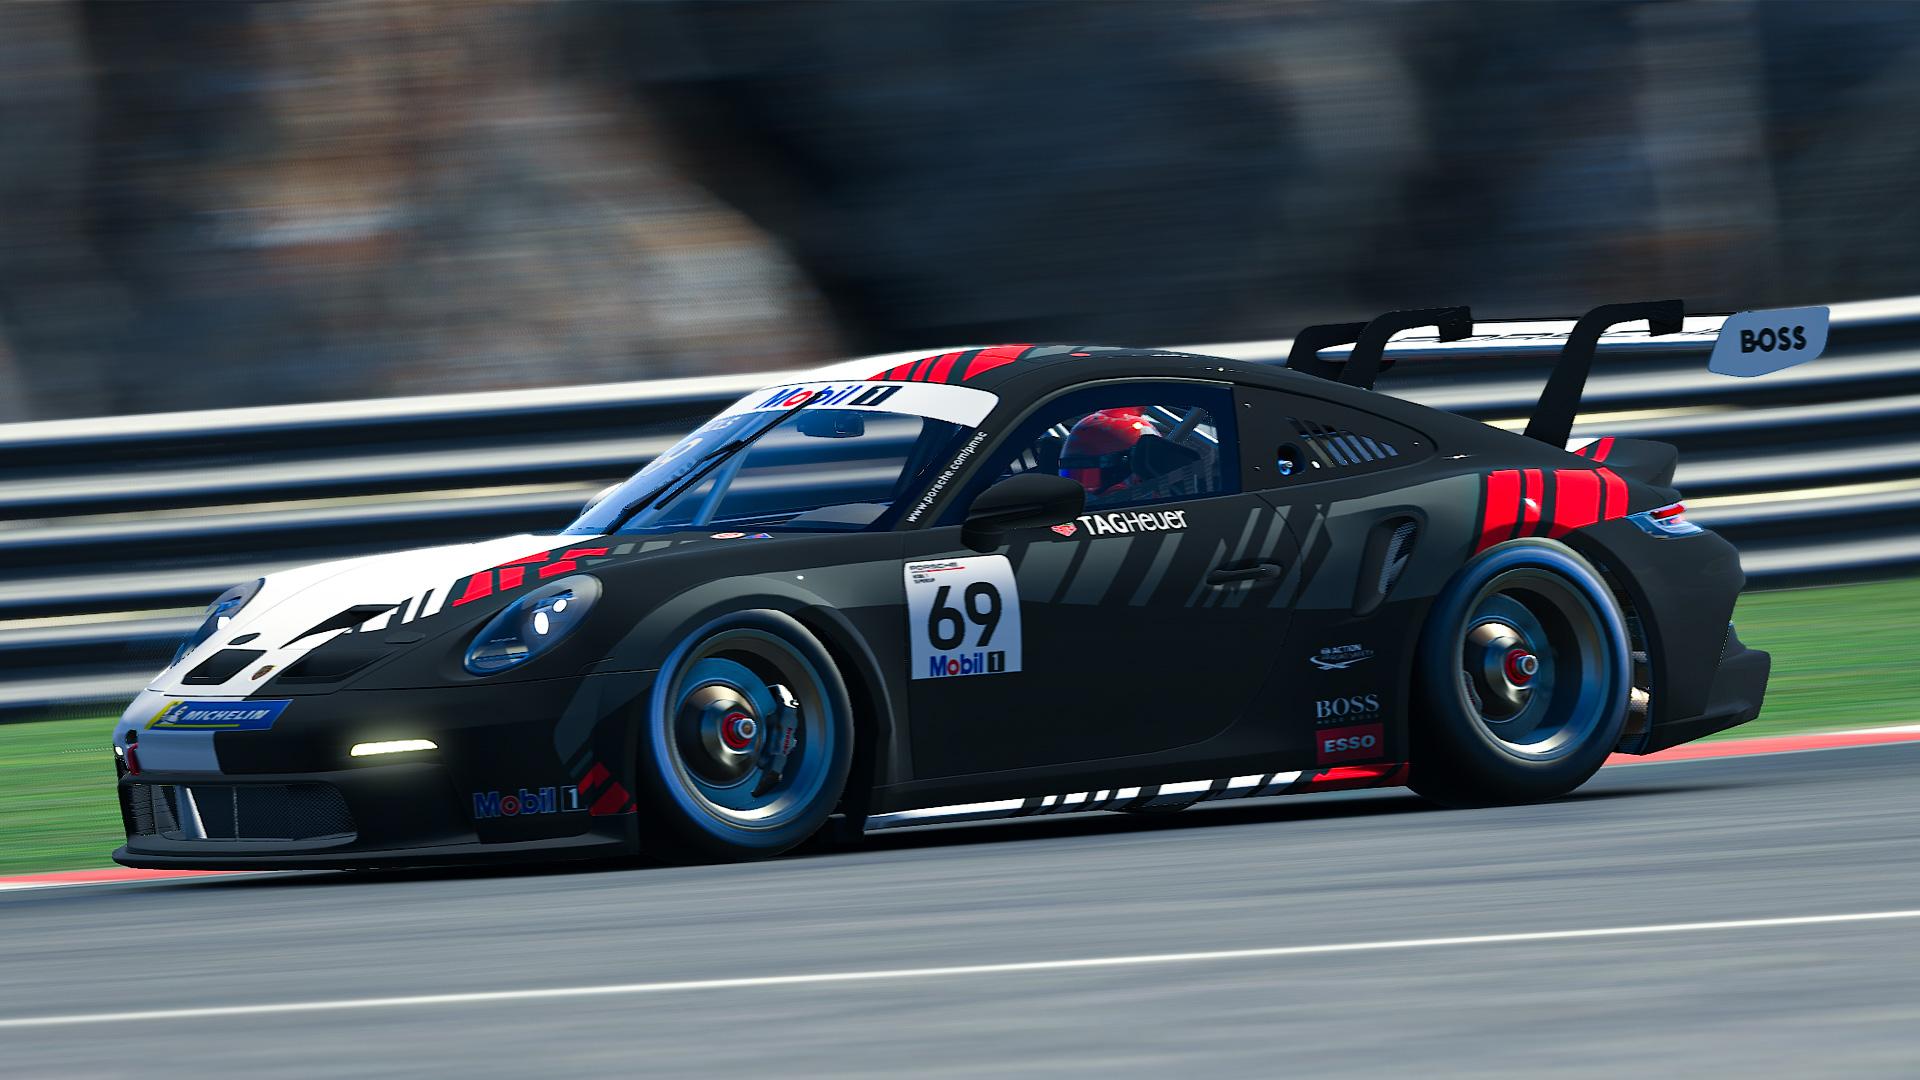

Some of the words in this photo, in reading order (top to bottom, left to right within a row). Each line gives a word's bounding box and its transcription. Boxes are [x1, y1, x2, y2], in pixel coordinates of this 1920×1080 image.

[1740, 325, 1807, 353] BOSS
[753, 385, 863, 410] Mobil
[852, 385, 901, 406] 1
[906, 431, 988, 522] www.porsche.com/pmsc
[928, 581, 1002, 651] 69
[930, 652, 984, 677] Mobil
[989, 652, 1004, 672] 1
[182, 709, 272, 721] MICHELIN
[1316, 694, 1380, 718] BOSS
[1324, 735, 1375, 753] ESSO
[472, 787, 556, 819] Mobil
